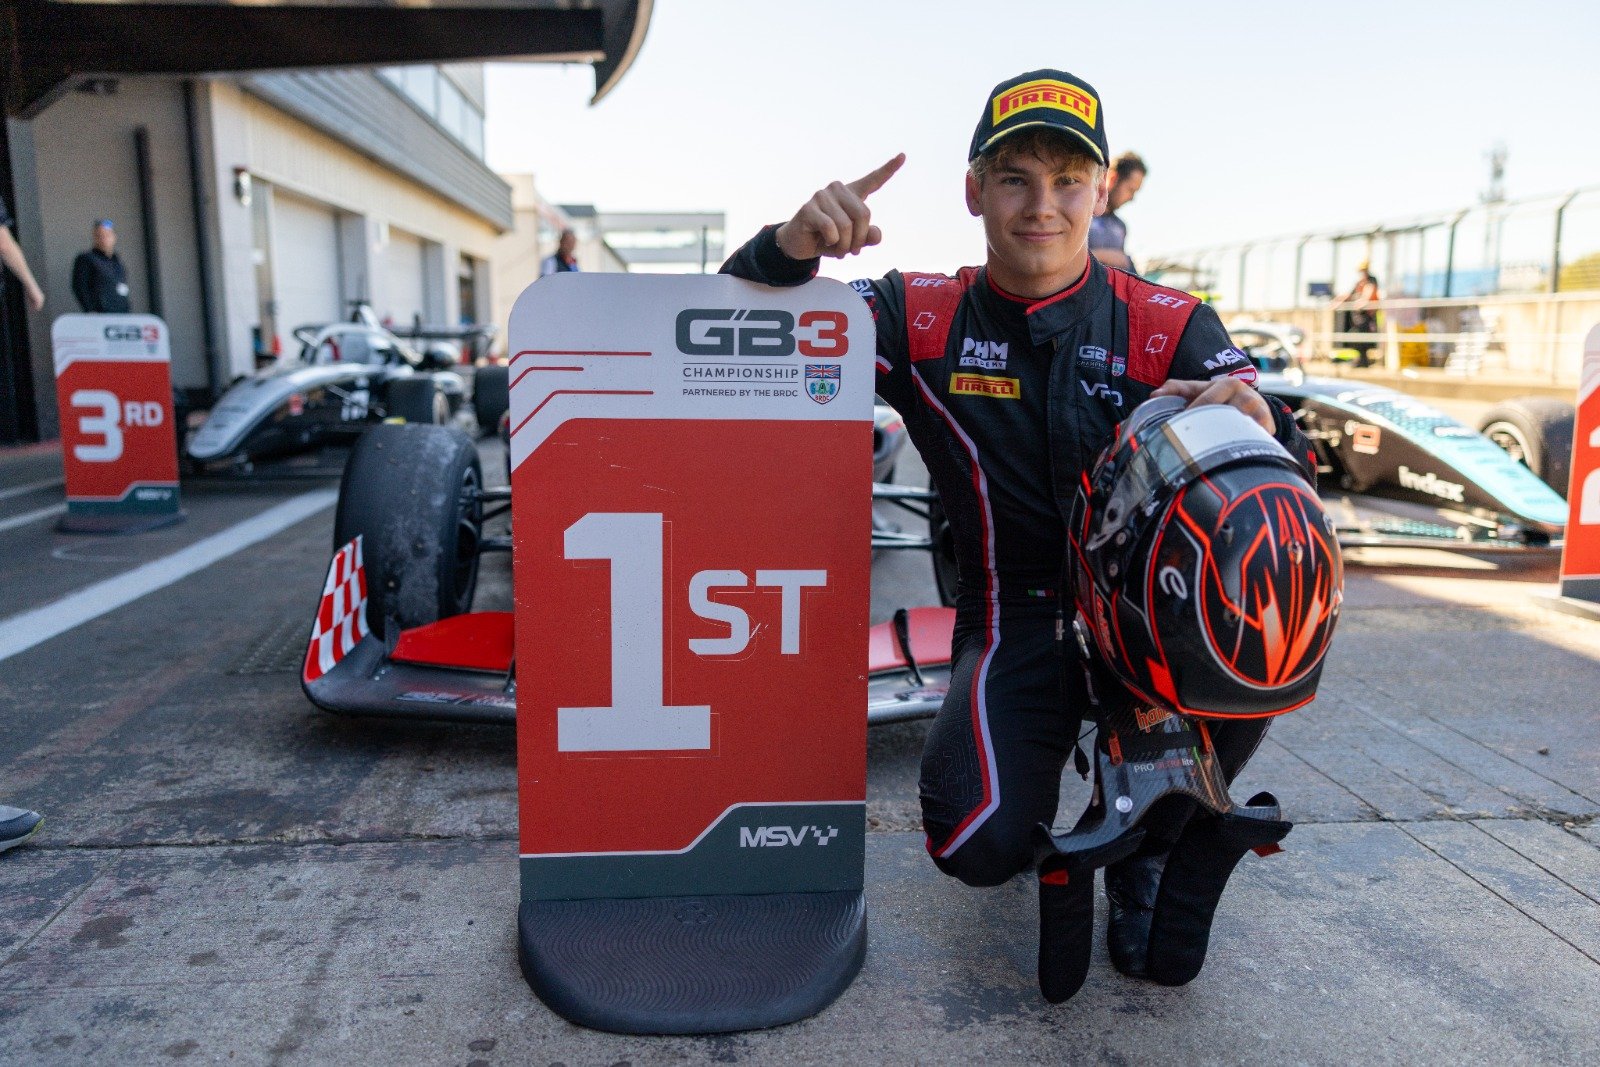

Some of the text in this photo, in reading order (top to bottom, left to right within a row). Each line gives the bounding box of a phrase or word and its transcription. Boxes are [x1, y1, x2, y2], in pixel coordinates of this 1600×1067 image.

[1000, 84, 1091, 117] PIRELLI
[1147, 293, 1189, 309] SET
[105, 325, 159, 342] GB3
[676, 308, 849, 357] GB3
[962, 337, 1008, 360] PHM
[683, 367, 798, 380] CHAMPIONSHIP
[683, 388, 798, 397] PARTNERED BY THE BRDC
[956, 376, 1013, 395] PIRELLI
[1134, 763, 1154, 773] PRO
[740, 825, 807, 847] MSV
